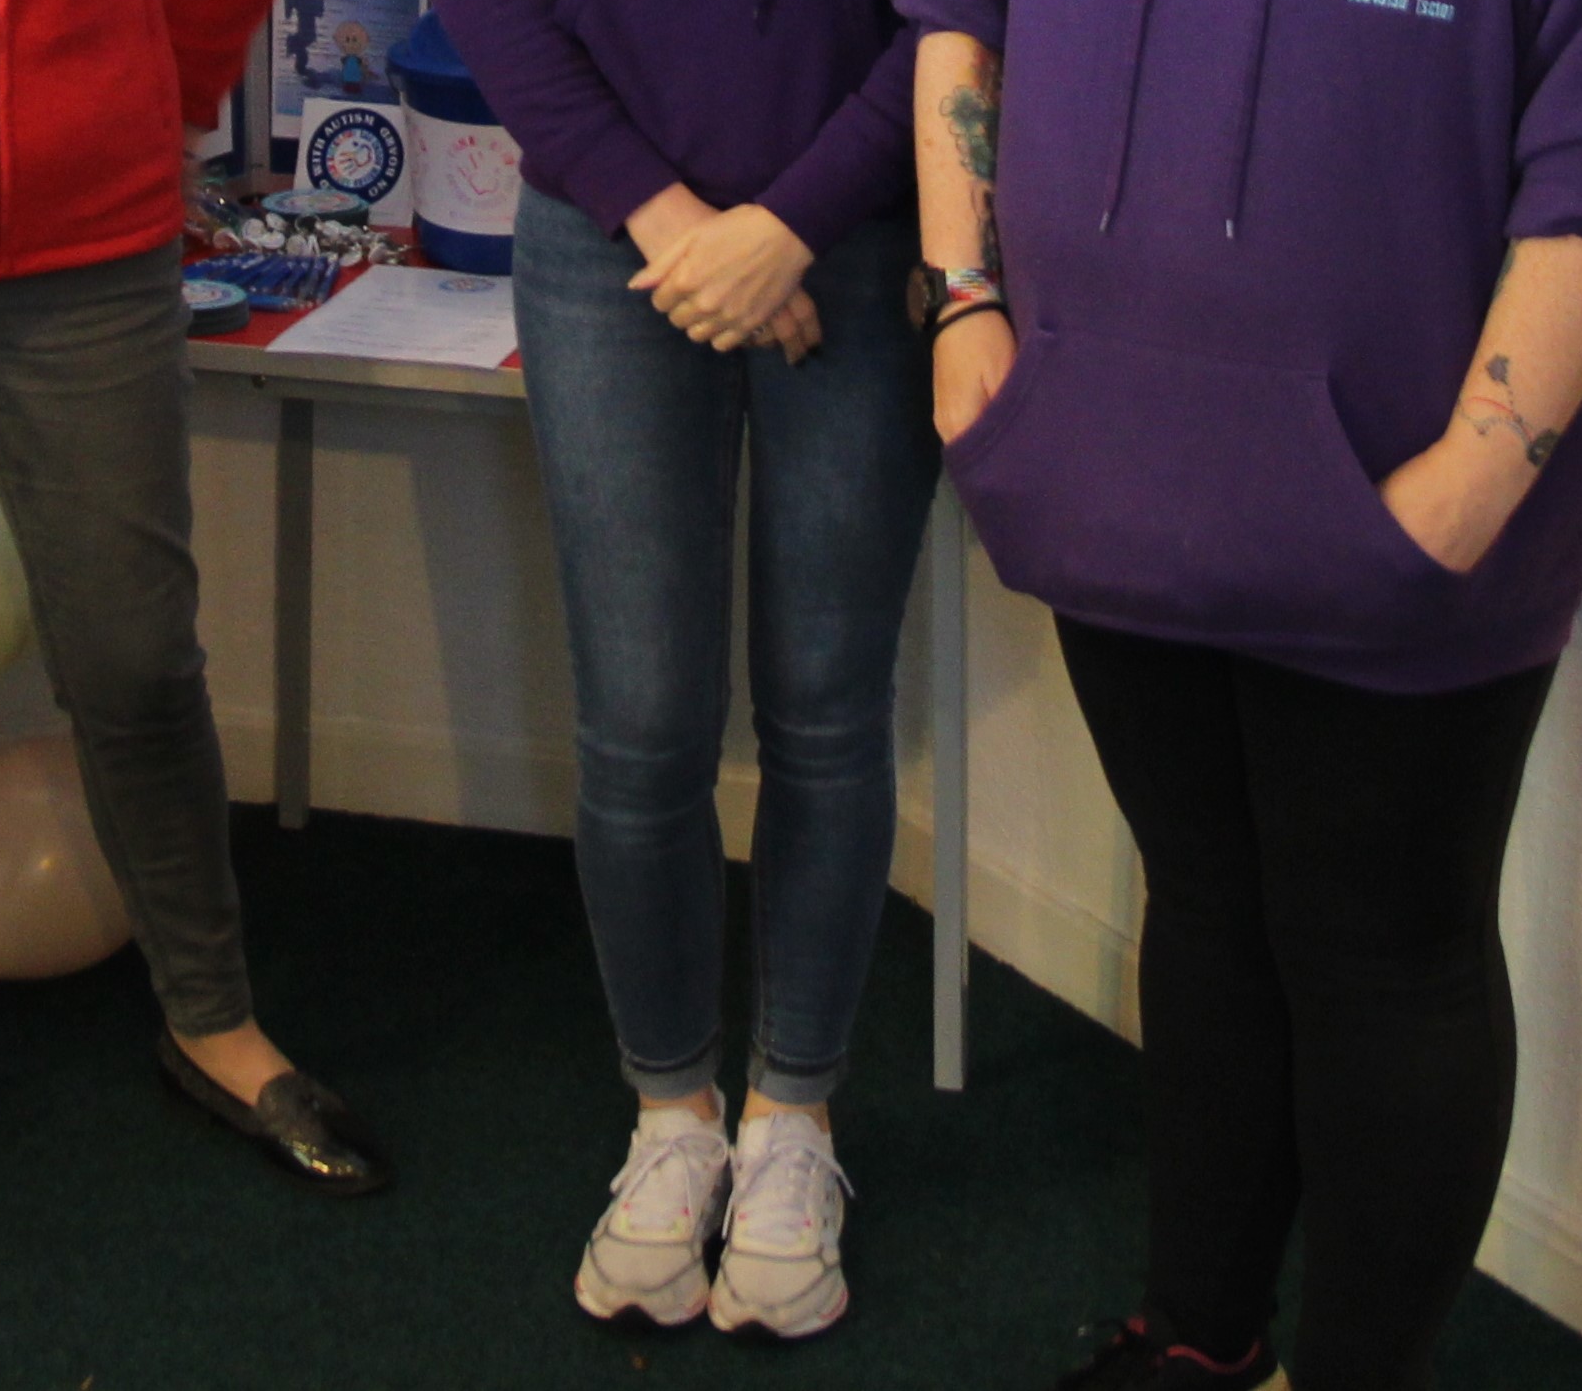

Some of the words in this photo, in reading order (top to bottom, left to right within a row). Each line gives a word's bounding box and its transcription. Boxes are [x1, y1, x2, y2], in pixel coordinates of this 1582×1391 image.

[312, 138, 326, 177] WITH
[324, 113, 375, 137] AUTISM
[379, 127, 398, 177] BOARD
